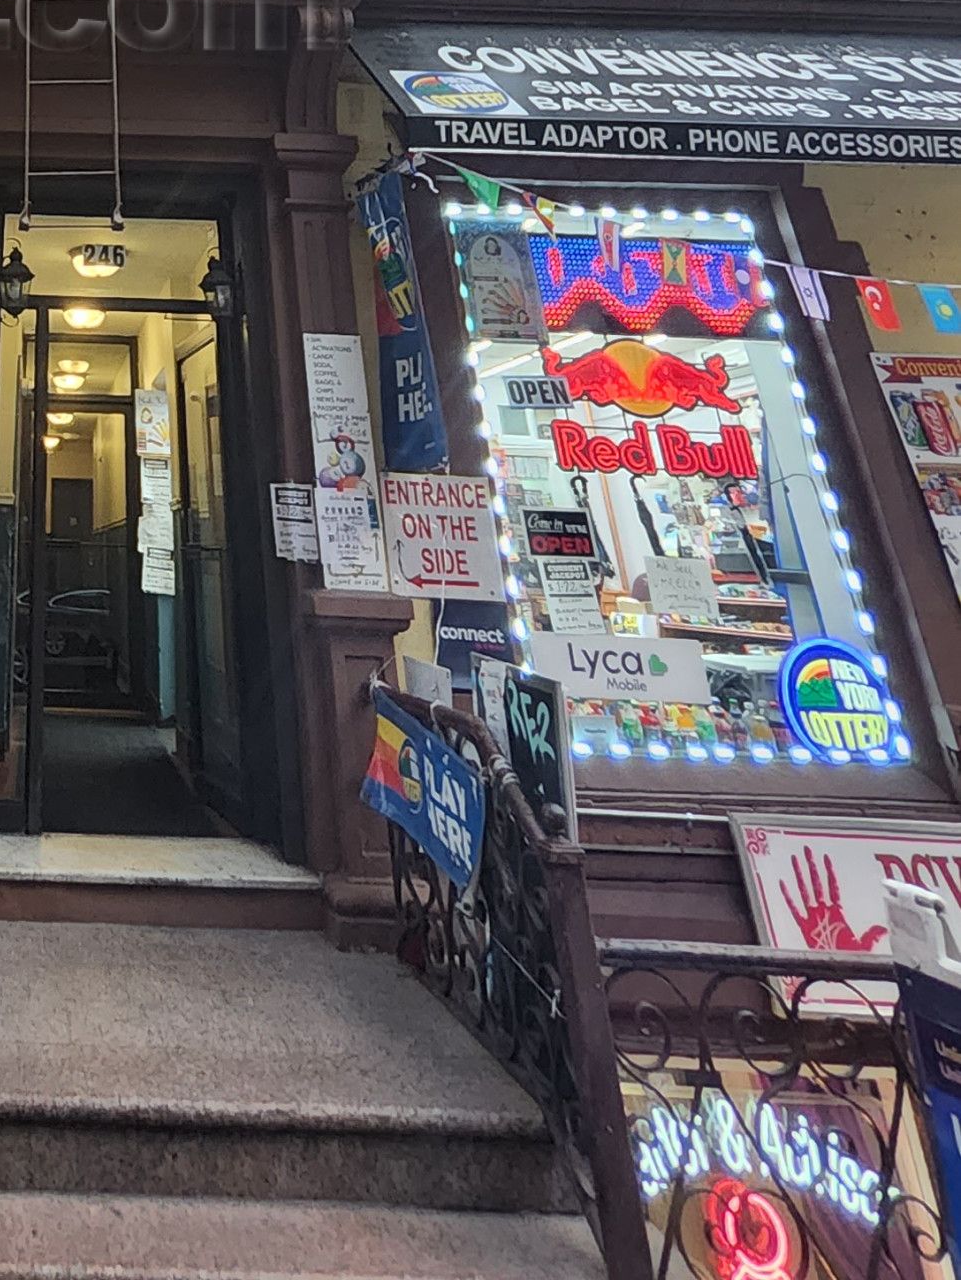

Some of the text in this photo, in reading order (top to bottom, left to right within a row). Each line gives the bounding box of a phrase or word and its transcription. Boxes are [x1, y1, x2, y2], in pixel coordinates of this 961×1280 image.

[437, 45, 961, 83] CONVENIENCE STO
[531, 80, 602, 96] SIM
[609, 81, 851, 103] ACTIVATIONS
[528, 96, 670, 115] BAGEL
[672, 99, 707, 115] &
[709, 100, 831, 118] CHIPS
[434, 120, 536, 146] TRAVEL
[541, 124, 668, 150] ADAPTOR
[688, 128, 780, 154] PHONE
[785, 131, 961, 158] ACCESSORIES
[84, 244, 125, 268] 246
[507, 380, 570, 405] OPEN
[552, 419, 758, 479] Red Bull
[384, 479, 488, 509] ENTRANCE
[402, 513, 479, 542] ON THE
[531, 534, 591, 554] OPEN
[421, 548, 470, 575] SIDE
[440, 625, 505, 644] connect
[567, 641, 644, 679] Lyca
[829, 658, 869, 685] NEW
[606, 677, 648, 693] Mobile
[799, 710, 888, 752] LOTTERY
